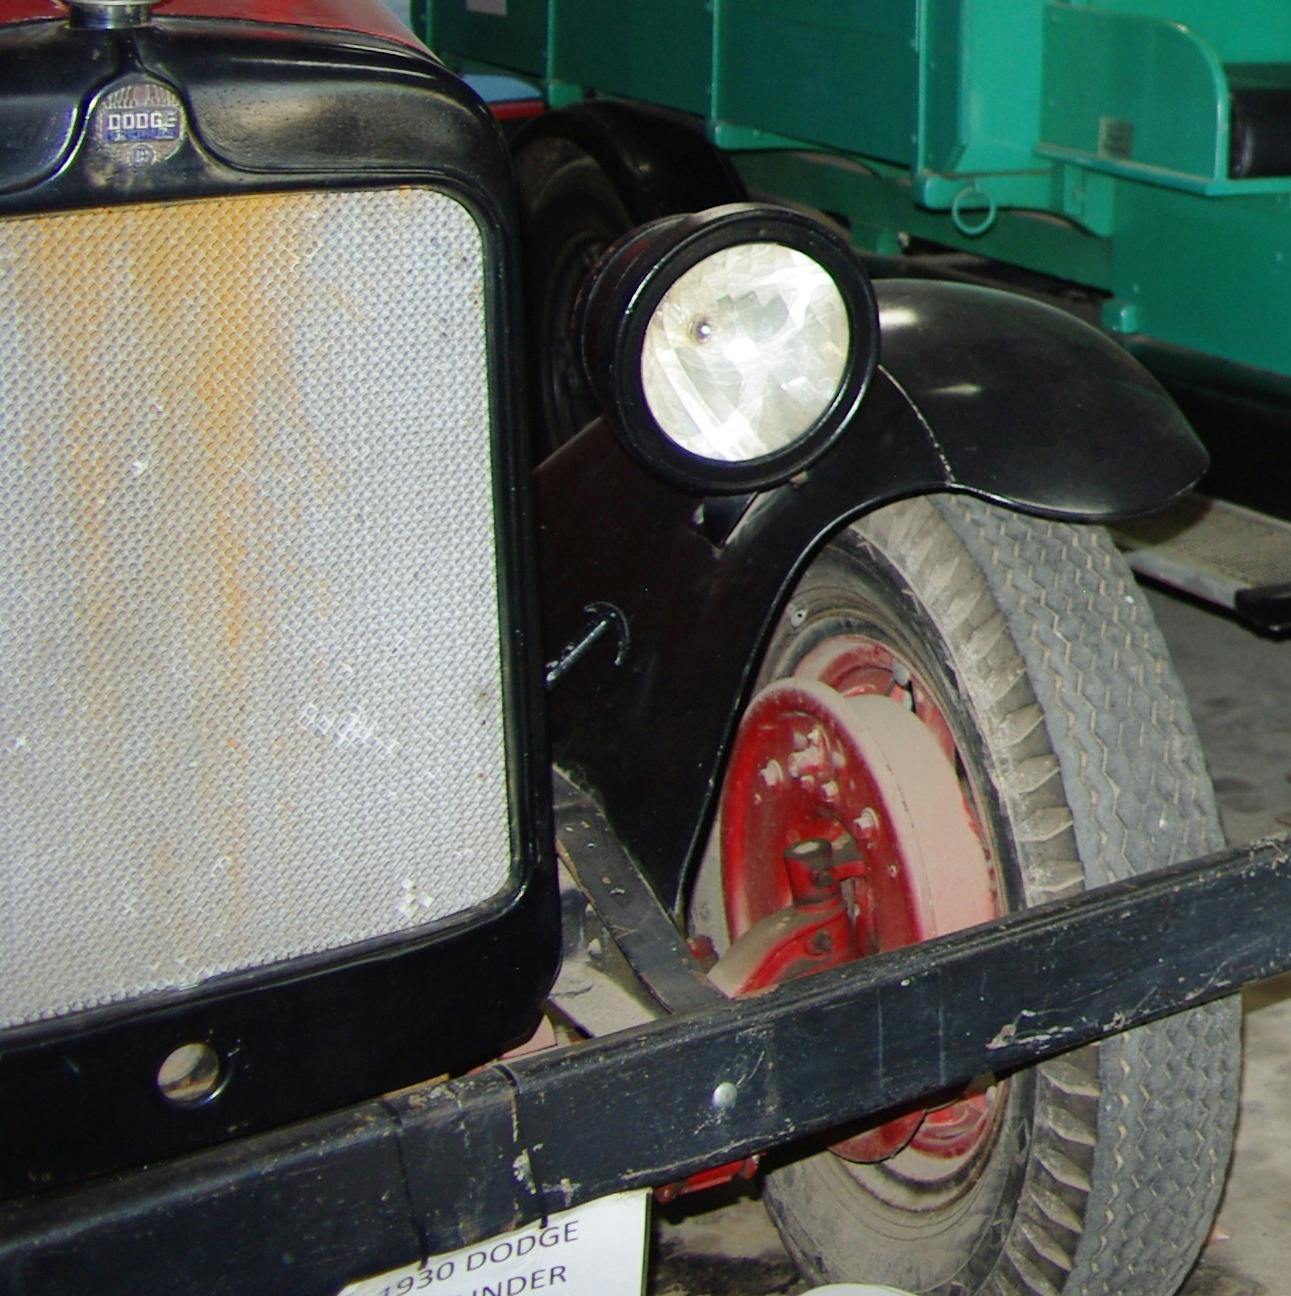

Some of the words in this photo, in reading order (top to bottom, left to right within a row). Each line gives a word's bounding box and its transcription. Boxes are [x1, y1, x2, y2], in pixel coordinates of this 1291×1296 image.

[107, 110, 178, 131] DODGE
[466, 1220, 579, 1272] DODGE
[472, 1265, 567, 1296] NDER
